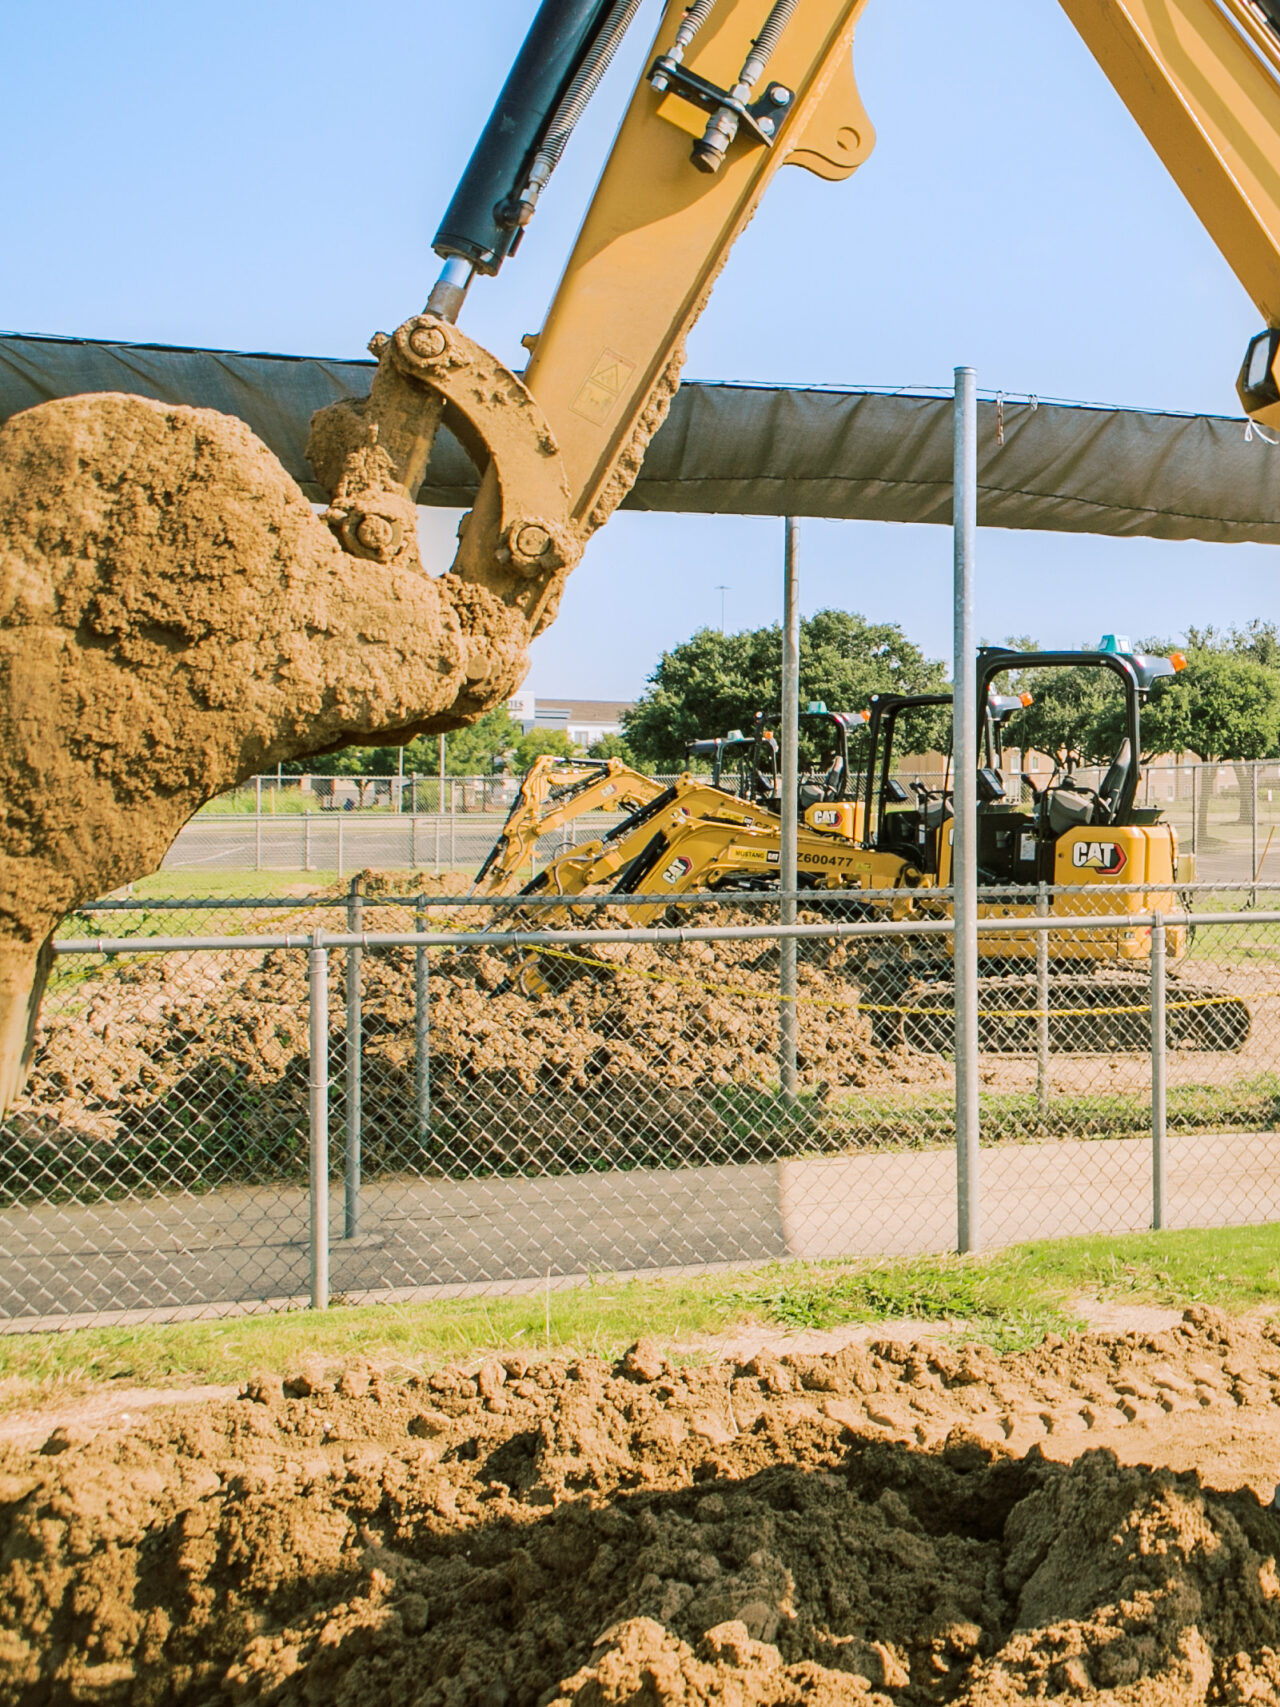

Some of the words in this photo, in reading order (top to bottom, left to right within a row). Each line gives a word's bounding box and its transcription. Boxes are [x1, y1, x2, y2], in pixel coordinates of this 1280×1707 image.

[814, 810, 837, 825] CAT
[796, 853, 853, 867] Z600477
[1073, 842, 1115, 868] CAT
[662, 858, 687, 885] CAT
